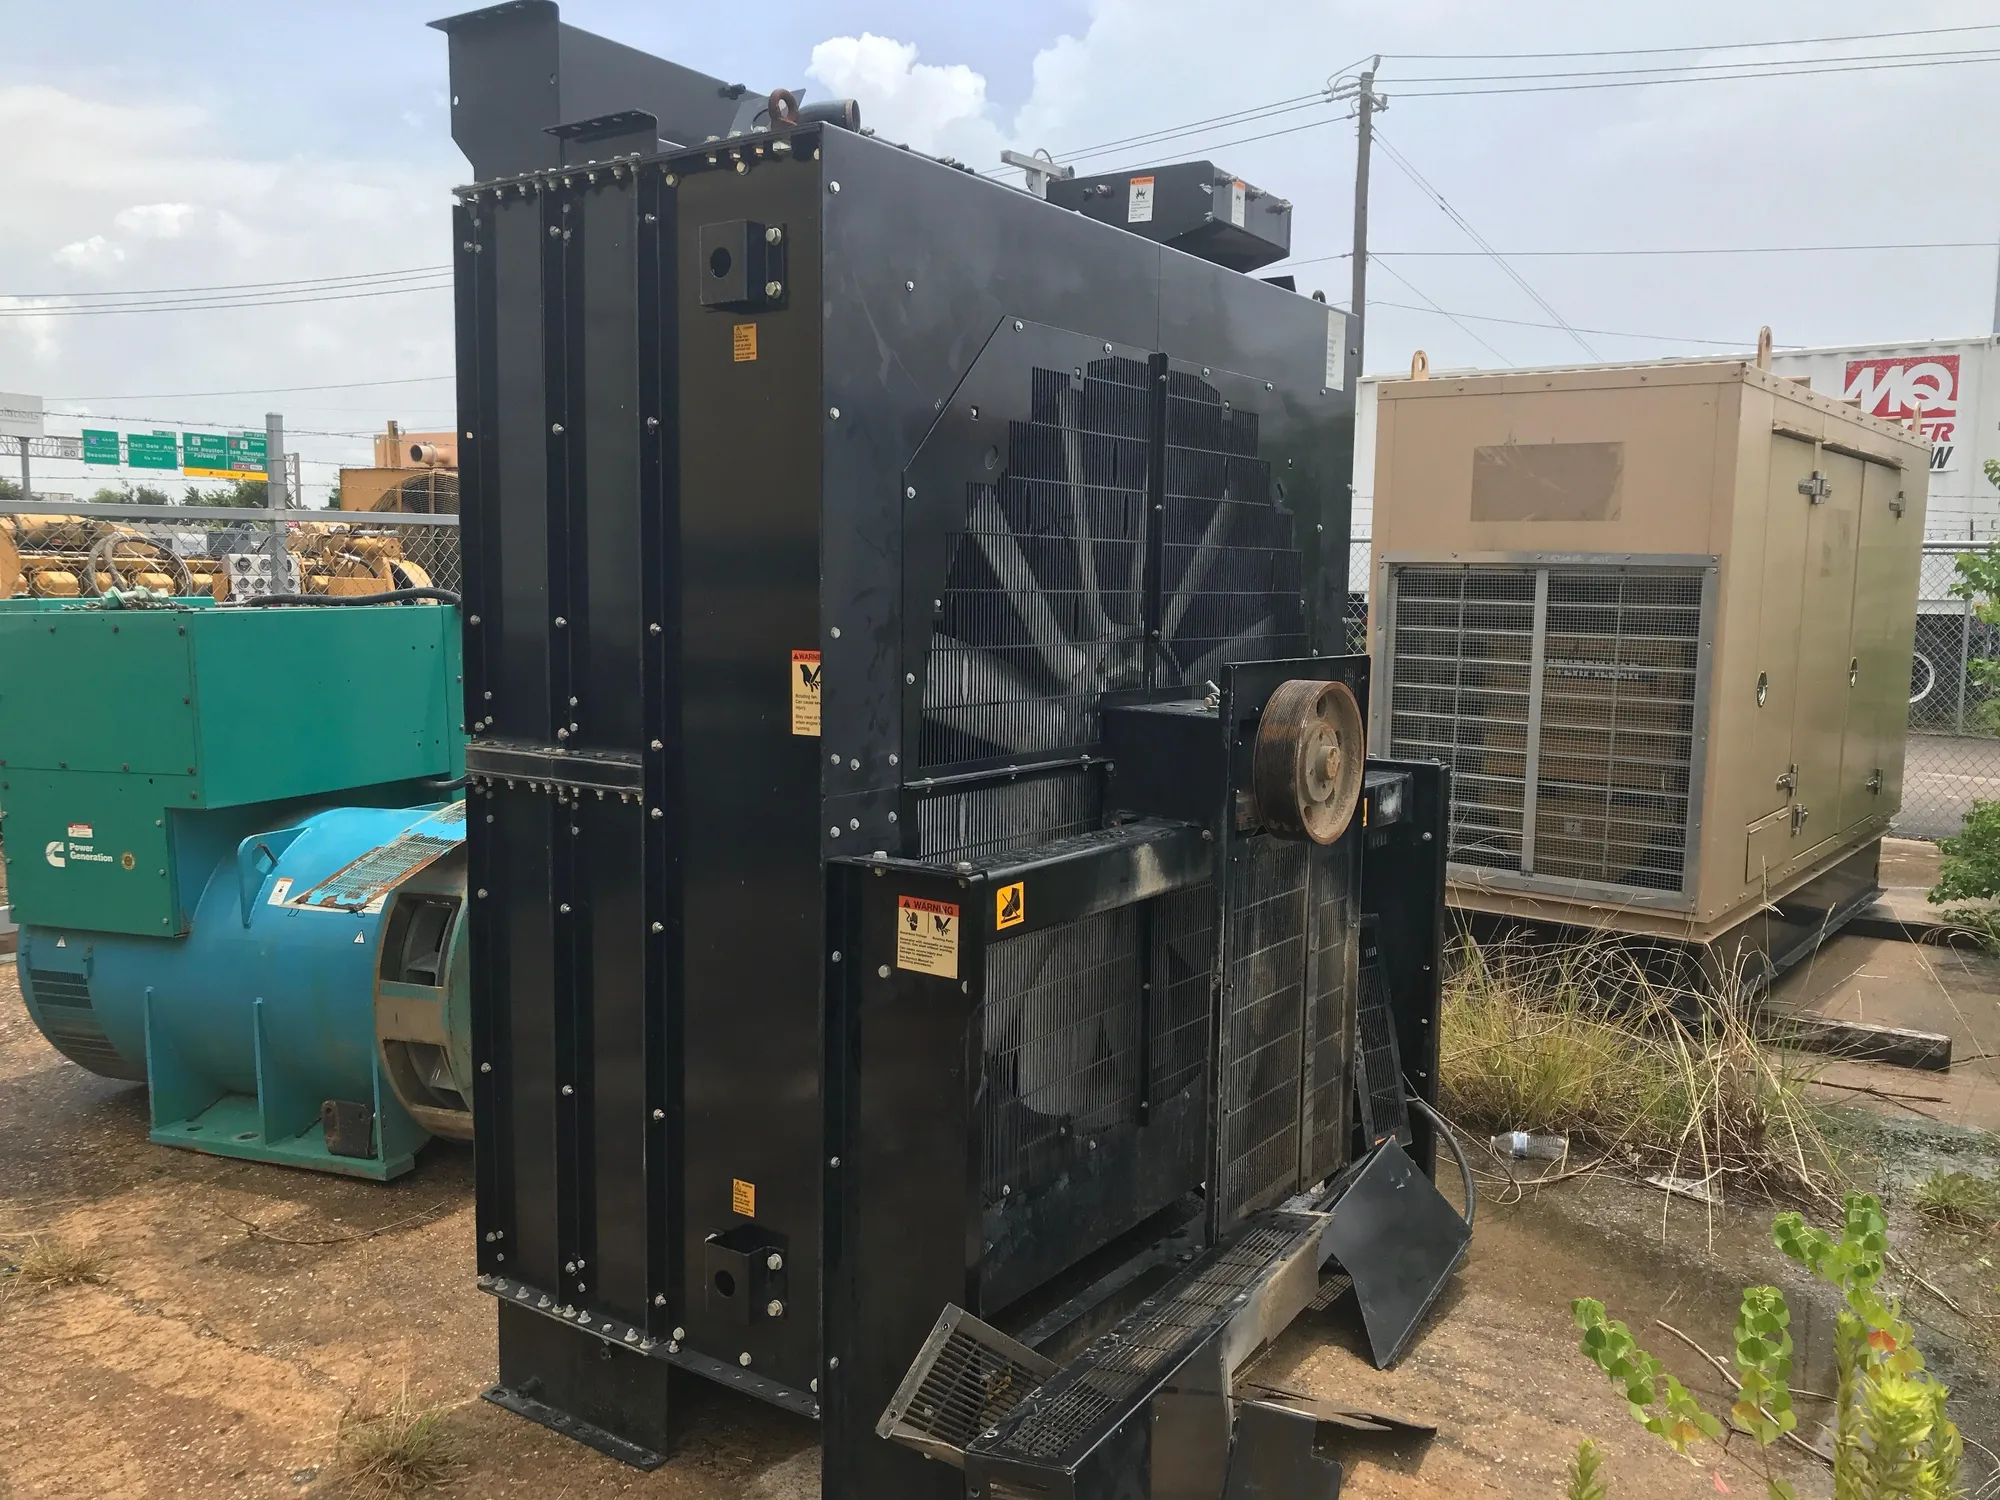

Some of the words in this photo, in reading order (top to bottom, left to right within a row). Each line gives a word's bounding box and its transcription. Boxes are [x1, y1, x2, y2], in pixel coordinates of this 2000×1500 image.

[1843, 361, 1957, 415] MQ
[86, 450, 118, 460] Beaumont
[69, 842, 94, 852] Power
[70, 851, 113, 862] Generation
[914, 900, 954, 915] WARNING
